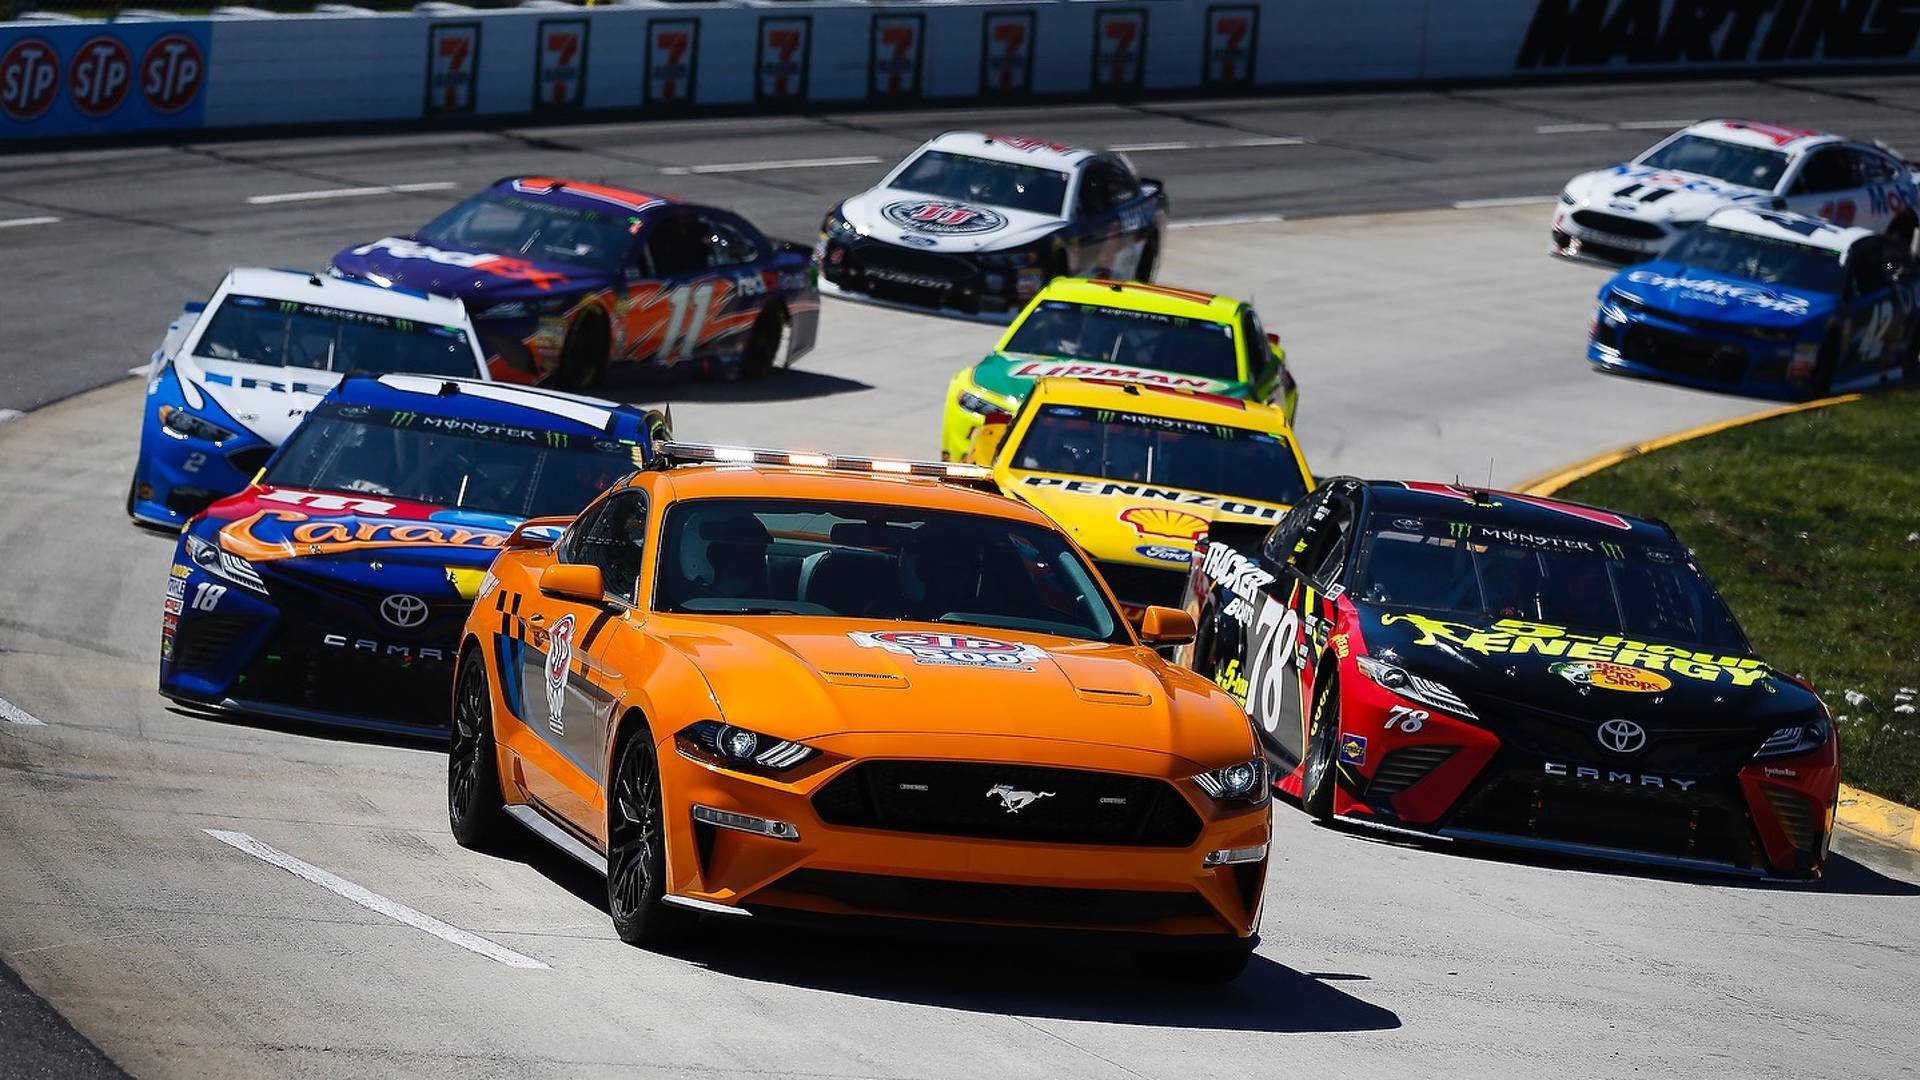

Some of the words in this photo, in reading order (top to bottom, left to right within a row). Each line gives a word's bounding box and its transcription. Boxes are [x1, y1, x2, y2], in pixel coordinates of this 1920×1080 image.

[3, 50, 54, 108] STP
[75, 45, 126, 105] STP
[147, 44, 198, 100] STP
[656, 283, 713, 359] 11
[1014, 363, 1208, 388] LIBMAN
[423, 416, 537, 441] MONSTER
[1121, 412, 1209, 433] MONSTER
[182, 452, 207, 473] 2
[1024, 476, 1290, 520] PENNZOI
[1481, 527, 1594, 551] MONSTER
[1146, 548, 1191, 563] Ford
[1202, 541, 1277, 604] TRACKER
[191, 582, 228, 612] 18
[324, 634, 458, 661] CAMR
[895, 632, 1003, 649] STP
[1491, 618, 1770, 669] 5-hour
[916, 649, 1022, 664] 500
[1245, 594, 1299, 733] 78
[1481, 632, 1768, 686] ENERGY
[1604, 675, 1662, 691] Shops
[1384, 704, 1430, 733] 78
[1544, 762, 1697, 791] CAMRY
